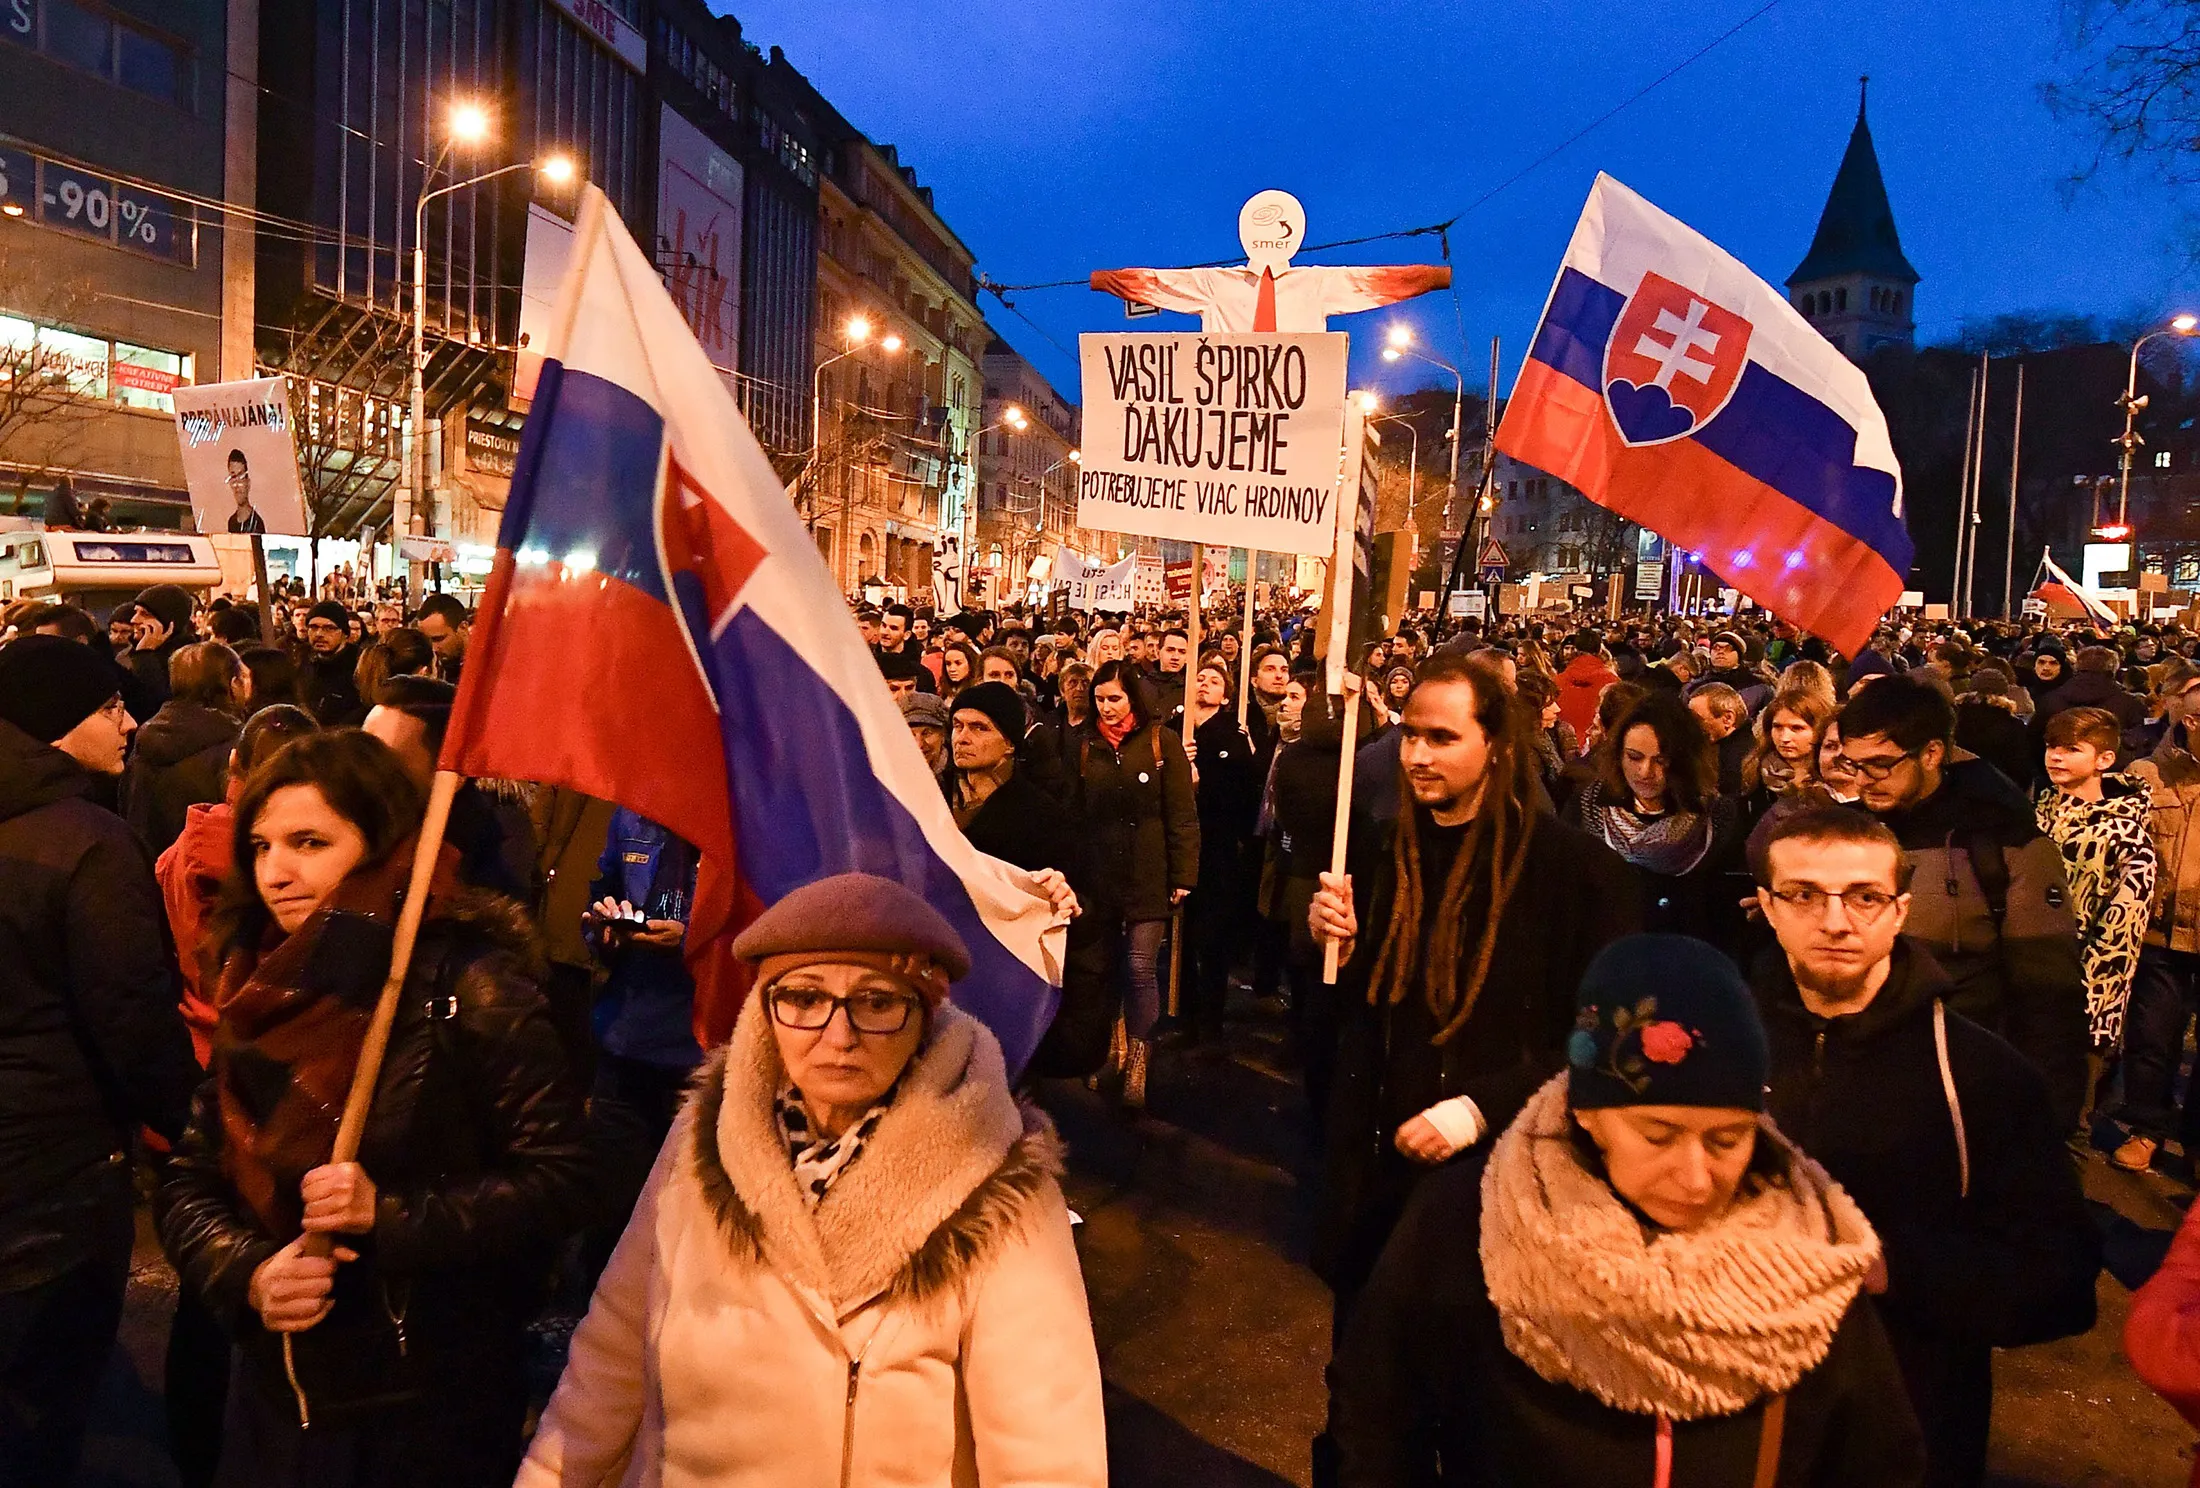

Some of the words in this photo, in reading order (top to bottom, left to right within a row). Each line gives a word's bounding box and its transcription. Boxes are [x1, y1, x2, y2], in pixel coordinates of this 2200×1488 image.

[1252, 239, 1291, 249] smer
[124, 377, 170, 391] POTREBY
[1194, 336, 1306, 410] ŠPIRKO
[468, 430, 511, 452] PRIESTORY
[1123, 401, 1290, 476] ĎAKUJEME
[1081, 470, 1188, 511] POTREBUJEME
[1194, 481, 1238, 515] VIAC
